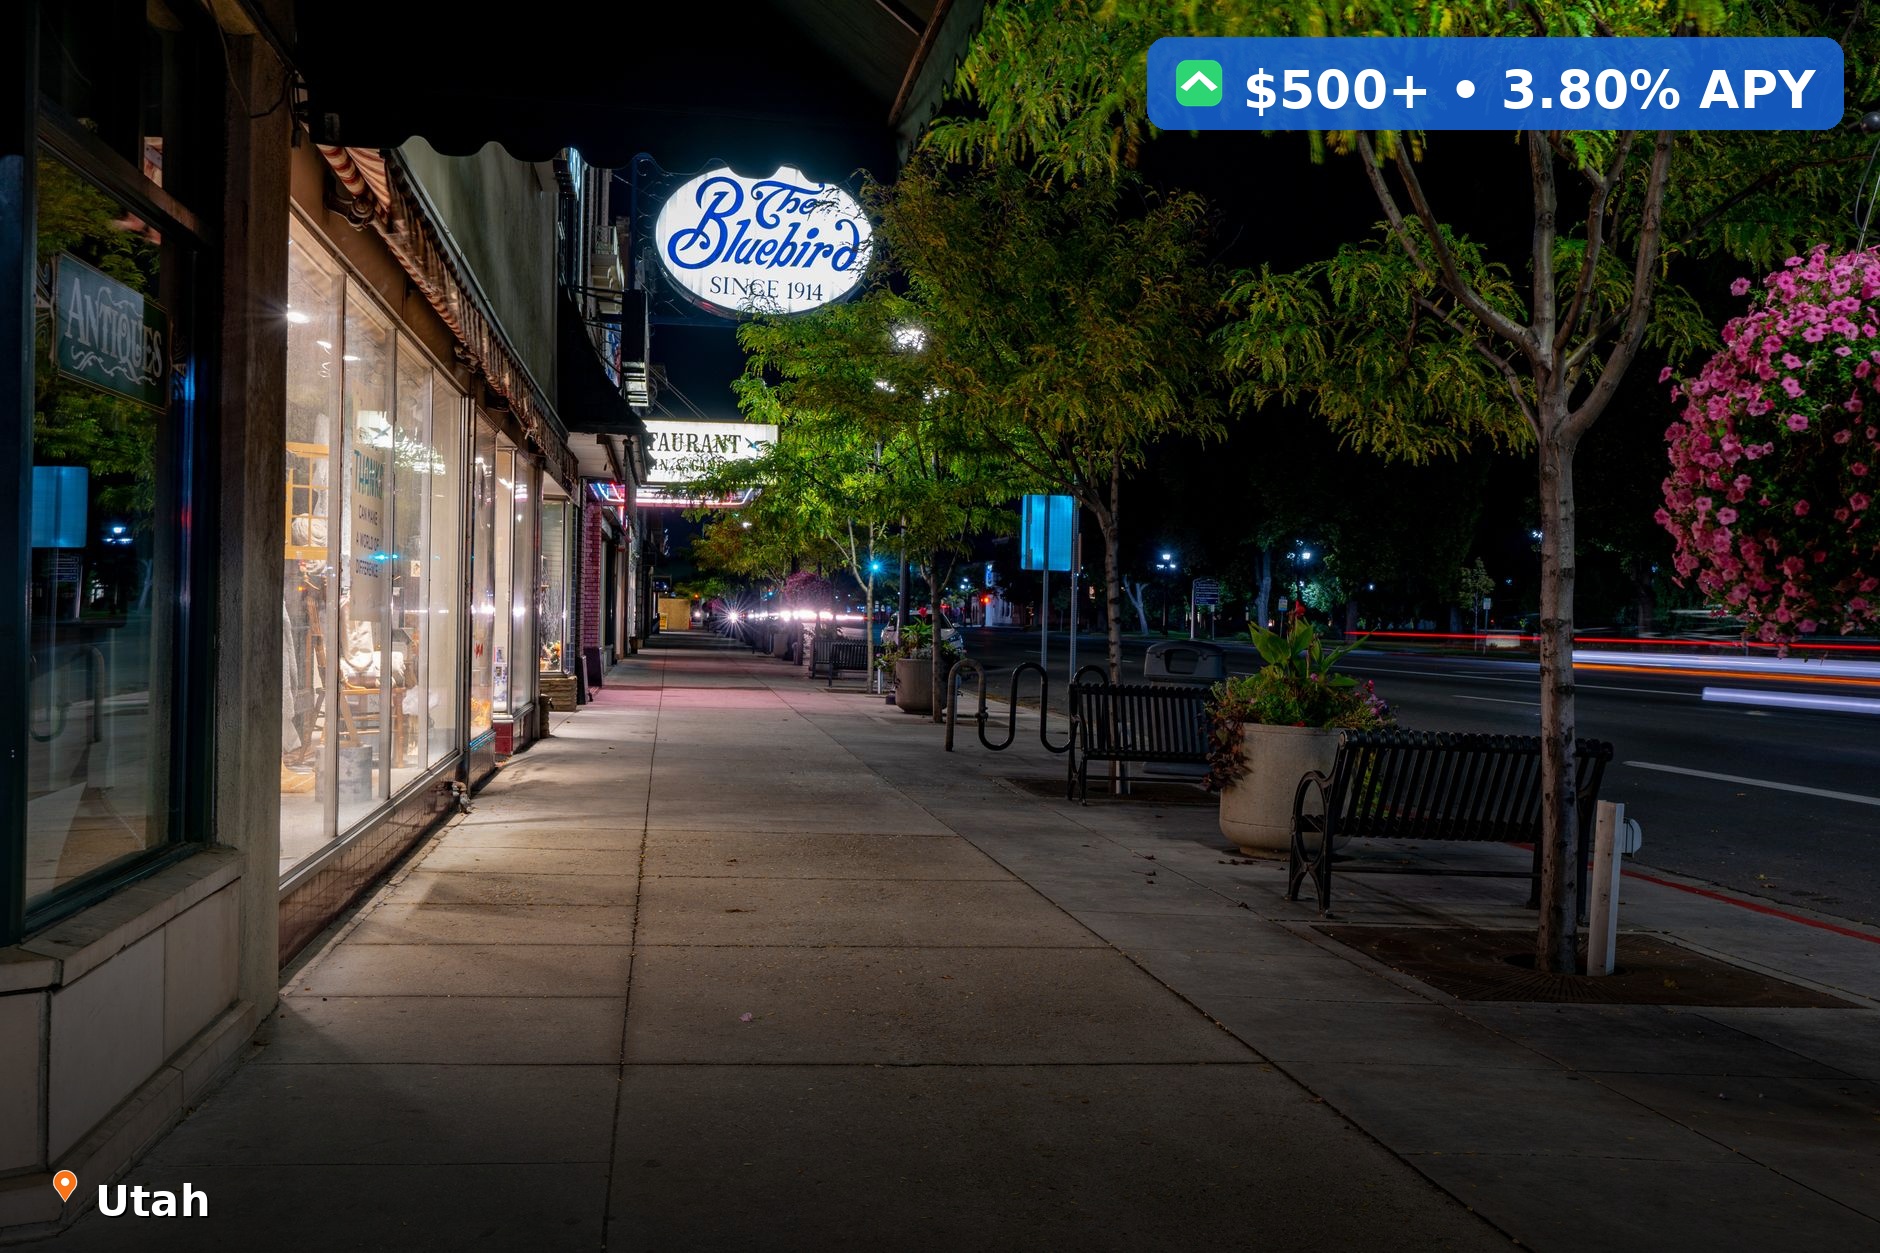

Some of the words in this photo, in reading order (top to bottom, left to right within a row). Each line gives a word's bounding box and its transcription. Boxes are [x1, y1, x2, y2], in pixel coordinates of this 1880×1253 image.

[667, 176, 861, 272] Bluebird
[751, 180, 825, 229] The
[710, 275, 779, 298] SINCE
[787, 281, 823, 301] 1914
[64, 276, 163, 384] ANTIQUES
[359, 504, 367, 520] CAN
